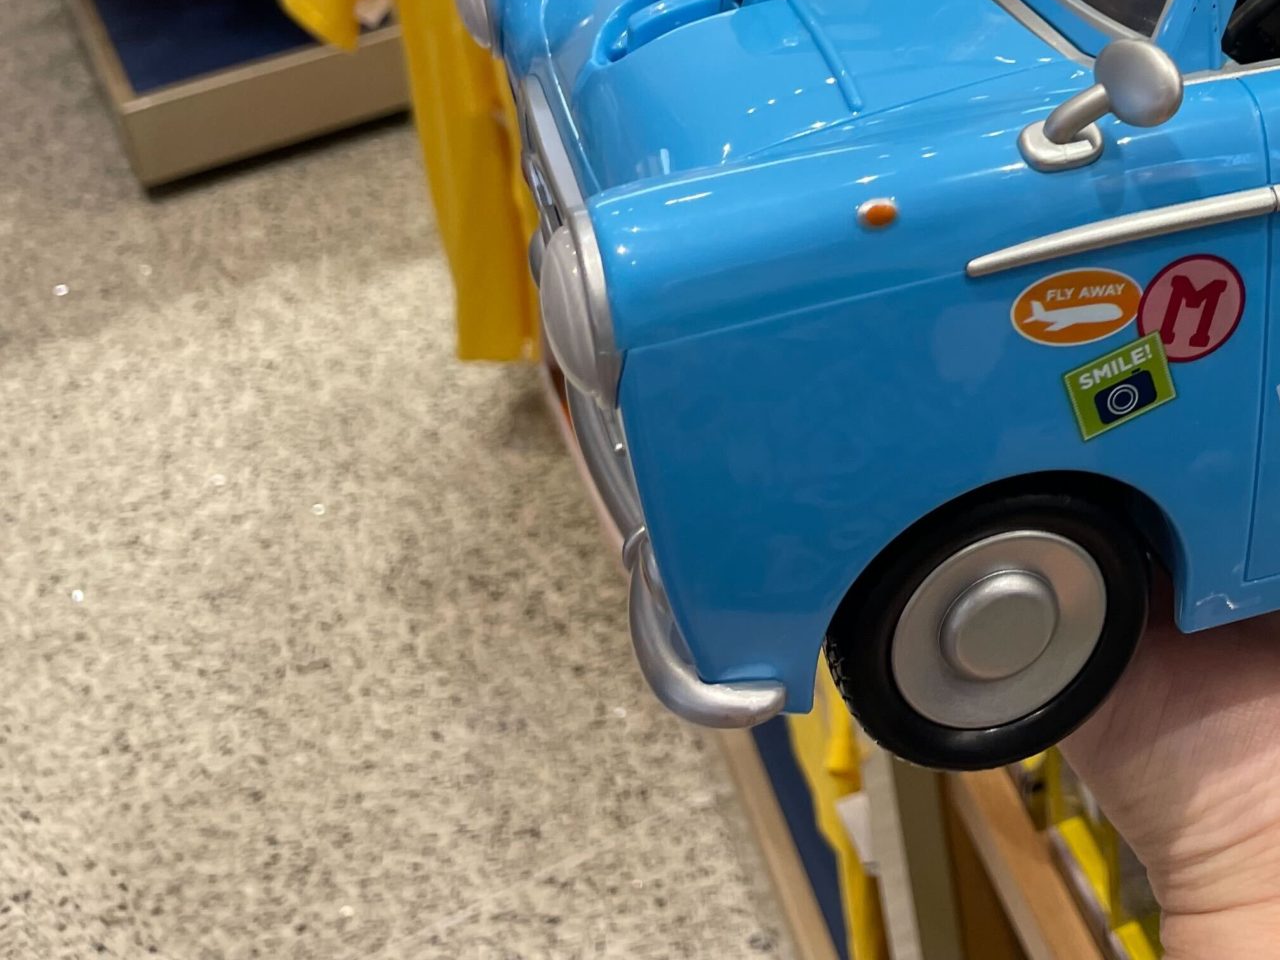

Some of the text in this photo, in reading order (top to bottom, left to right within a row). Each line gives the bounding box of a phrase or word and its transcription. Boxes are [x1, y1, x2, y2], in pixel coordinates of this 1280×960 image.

[1045, 283, 1126, 302] FLY AWAY
[1158, 275, 1228, 347] M
[1078, 344, 1153, 390] SMILE!
